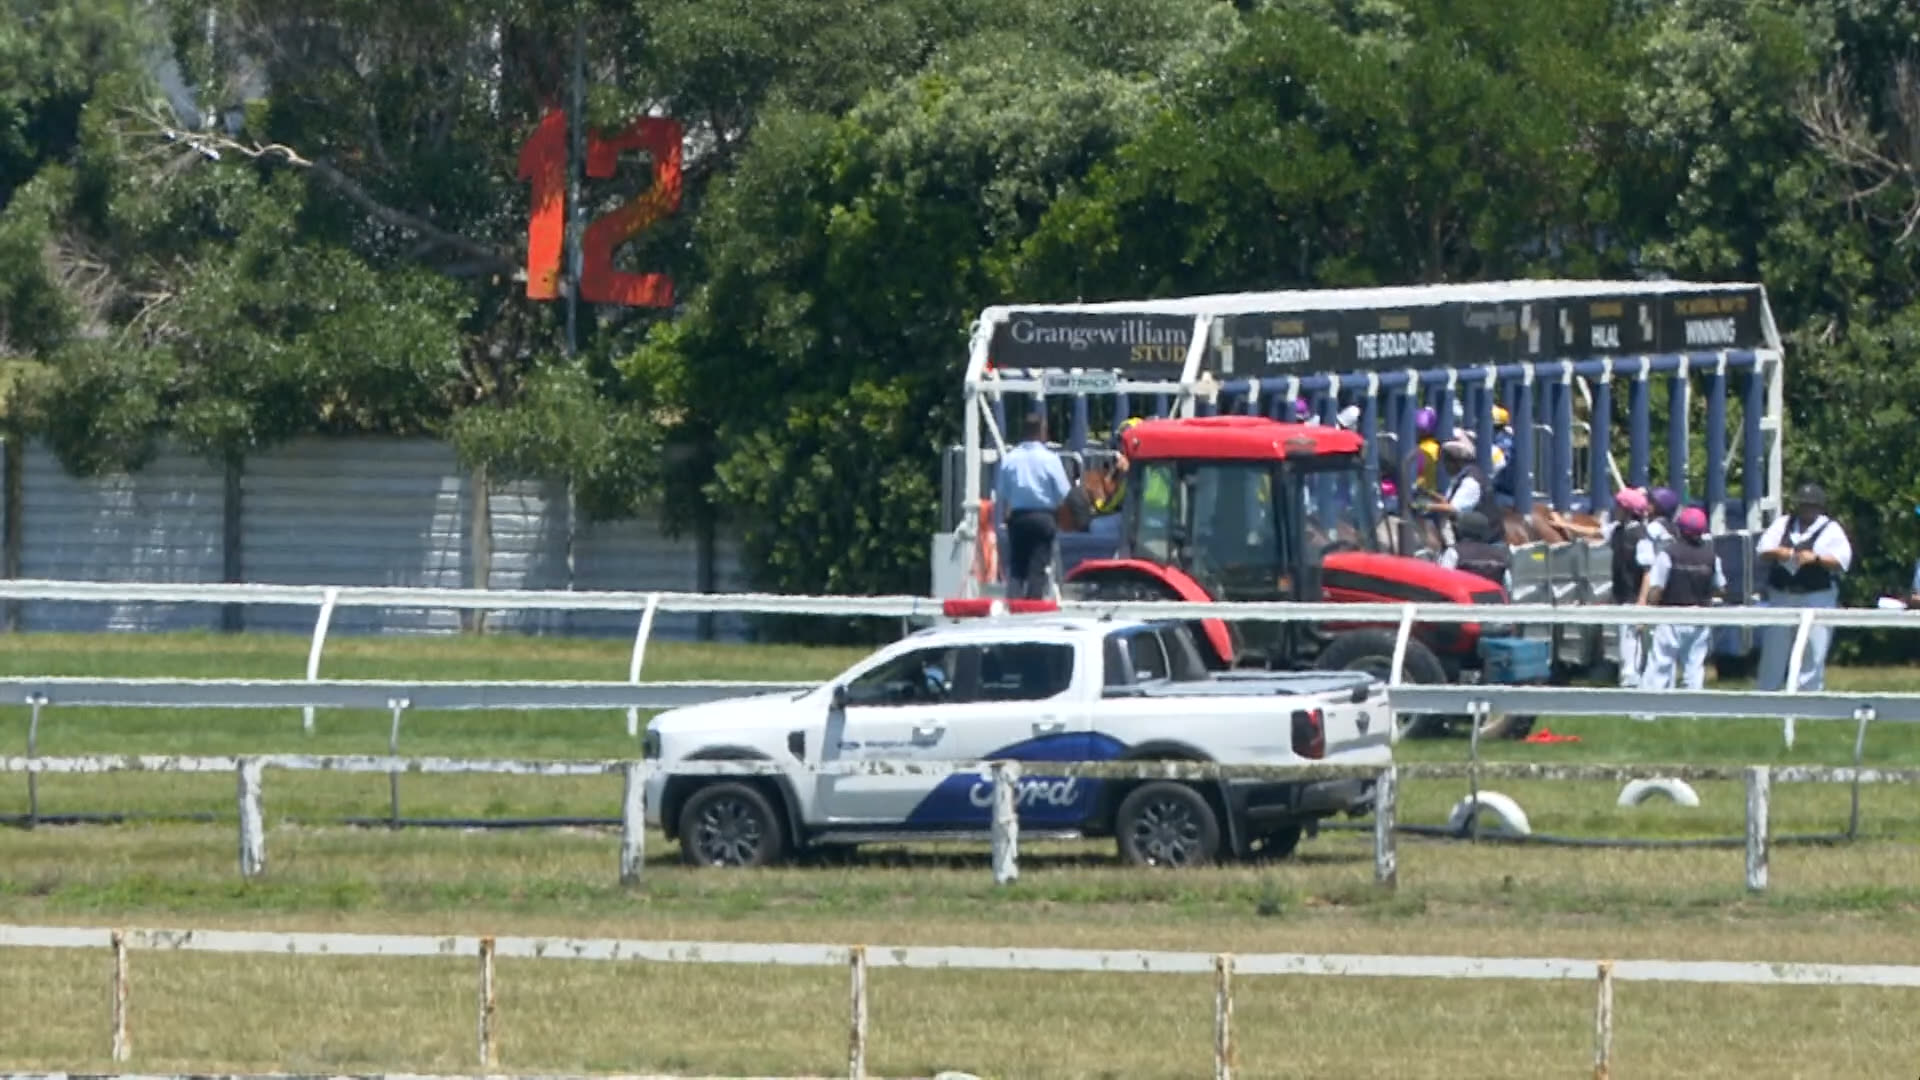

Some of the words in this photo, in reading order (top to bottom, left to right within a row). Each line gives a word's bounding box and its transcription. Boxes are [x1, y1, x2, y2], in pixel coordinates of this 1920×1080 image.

[517, 108, 684, 307] 12
[1011, 319, 1186, 350] Grangewilliam
[1355, 333, 1378, 360] THE
[1379, 331, 1408, 358] BOLD
[1409, 330, 1435, 356] ONE
[1130, 345, 1186, 363] STUD
[1266, 336, 1310, 364] DERRYN
